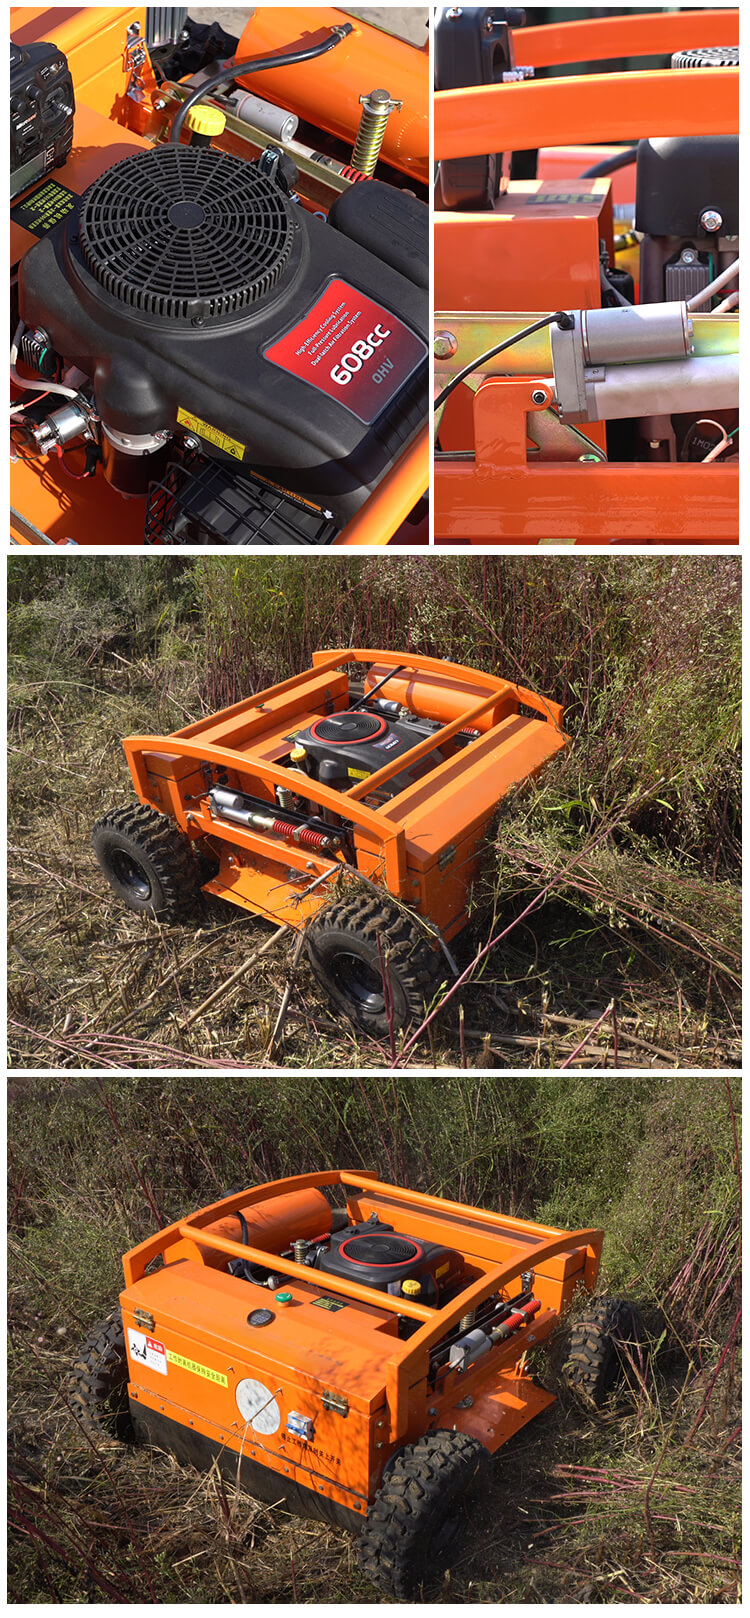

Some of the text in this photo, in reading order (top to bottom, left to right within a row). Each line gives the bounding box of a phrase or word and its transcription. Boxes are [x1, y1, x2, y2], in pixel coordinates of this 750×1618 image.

[295, 302, 346, 356] High-Efficiency Cooling System
[307, 311, 350, 356] Full-Pressure Lubrication
[333, 324, 350, 341] Filtration
[347, 311, 362, 325] System
[330, 323, 392, 386] 608cc
[371, 357, 394, 384] OHV
